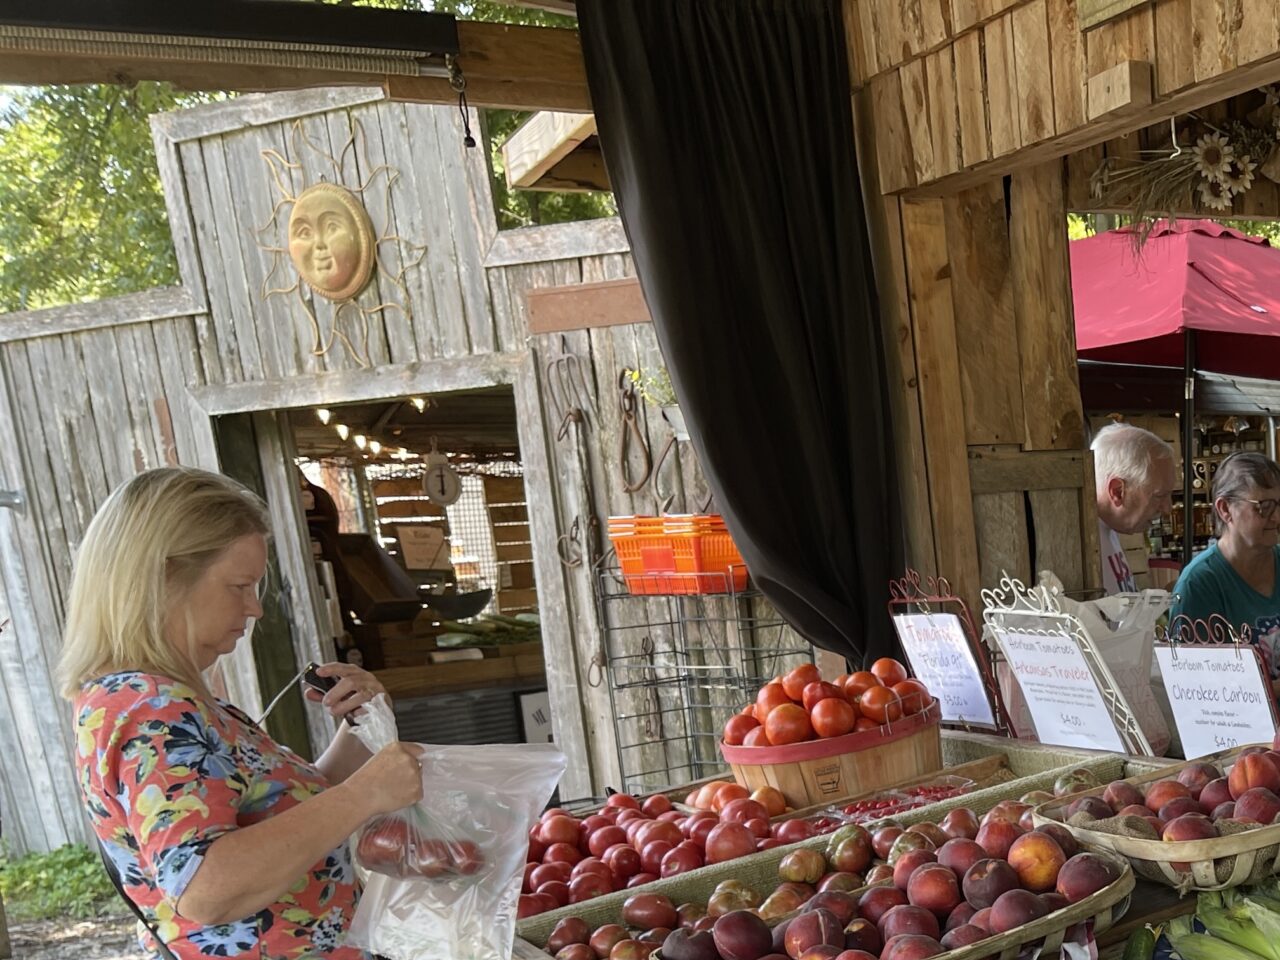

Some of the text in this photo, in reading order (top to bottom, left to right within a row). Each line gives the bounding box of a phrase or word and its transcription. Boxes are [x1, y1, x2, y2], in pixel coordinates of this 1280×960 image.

[1051, 665, 1090, 681] Traveler
[1172, 659, 1245, 673] Heirloom Tomatoes
[1172, 683, 1262, 704] Cherokee Carbon
